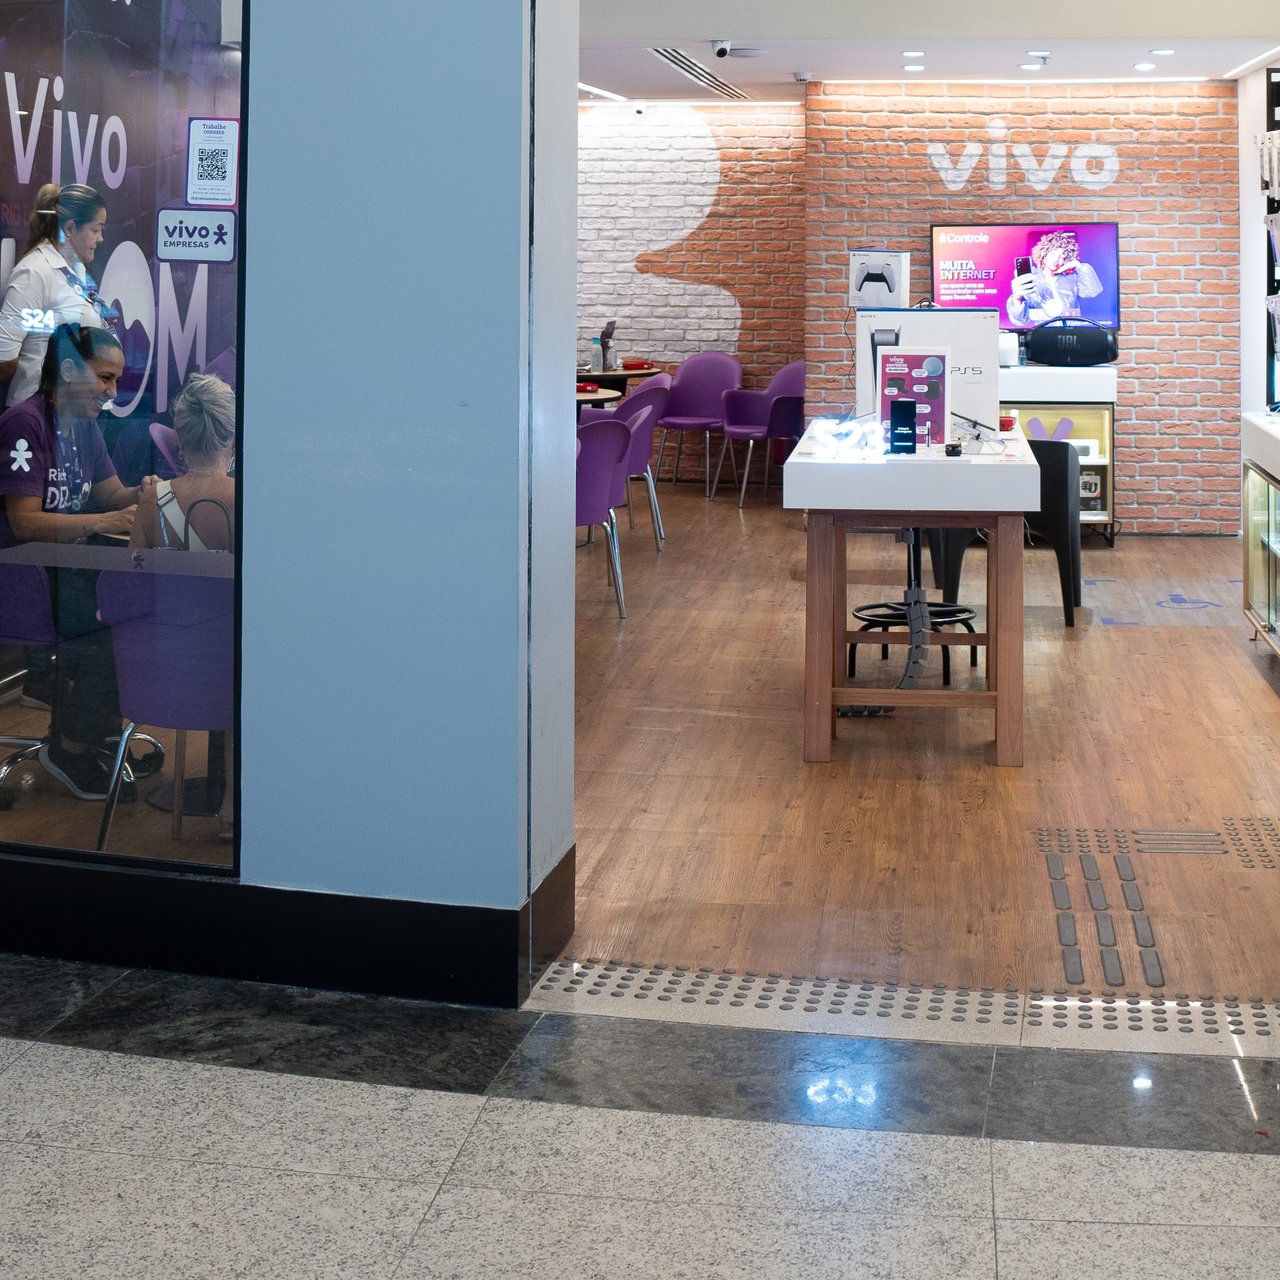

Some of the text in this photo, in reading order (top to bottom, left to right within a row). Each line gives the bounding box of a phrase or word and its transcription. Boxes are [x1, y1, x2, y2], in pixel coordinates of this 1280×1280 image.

[927, 118, 1120, 191] vivo
[164, 220, 210, 239] vivo
[163, 240, 210, 249] EMPRESAS
[947, 233, 990, 243] Controle
[939, 260, 977, 270] MUITA
[939, 269, 998, 280] INTERNET
[21, 308, 55, 330] S24
[1057, 334, 1081, 350] JBL
[951, 366, 982, 375] PS5
[813, 421, 886, 458] S23
